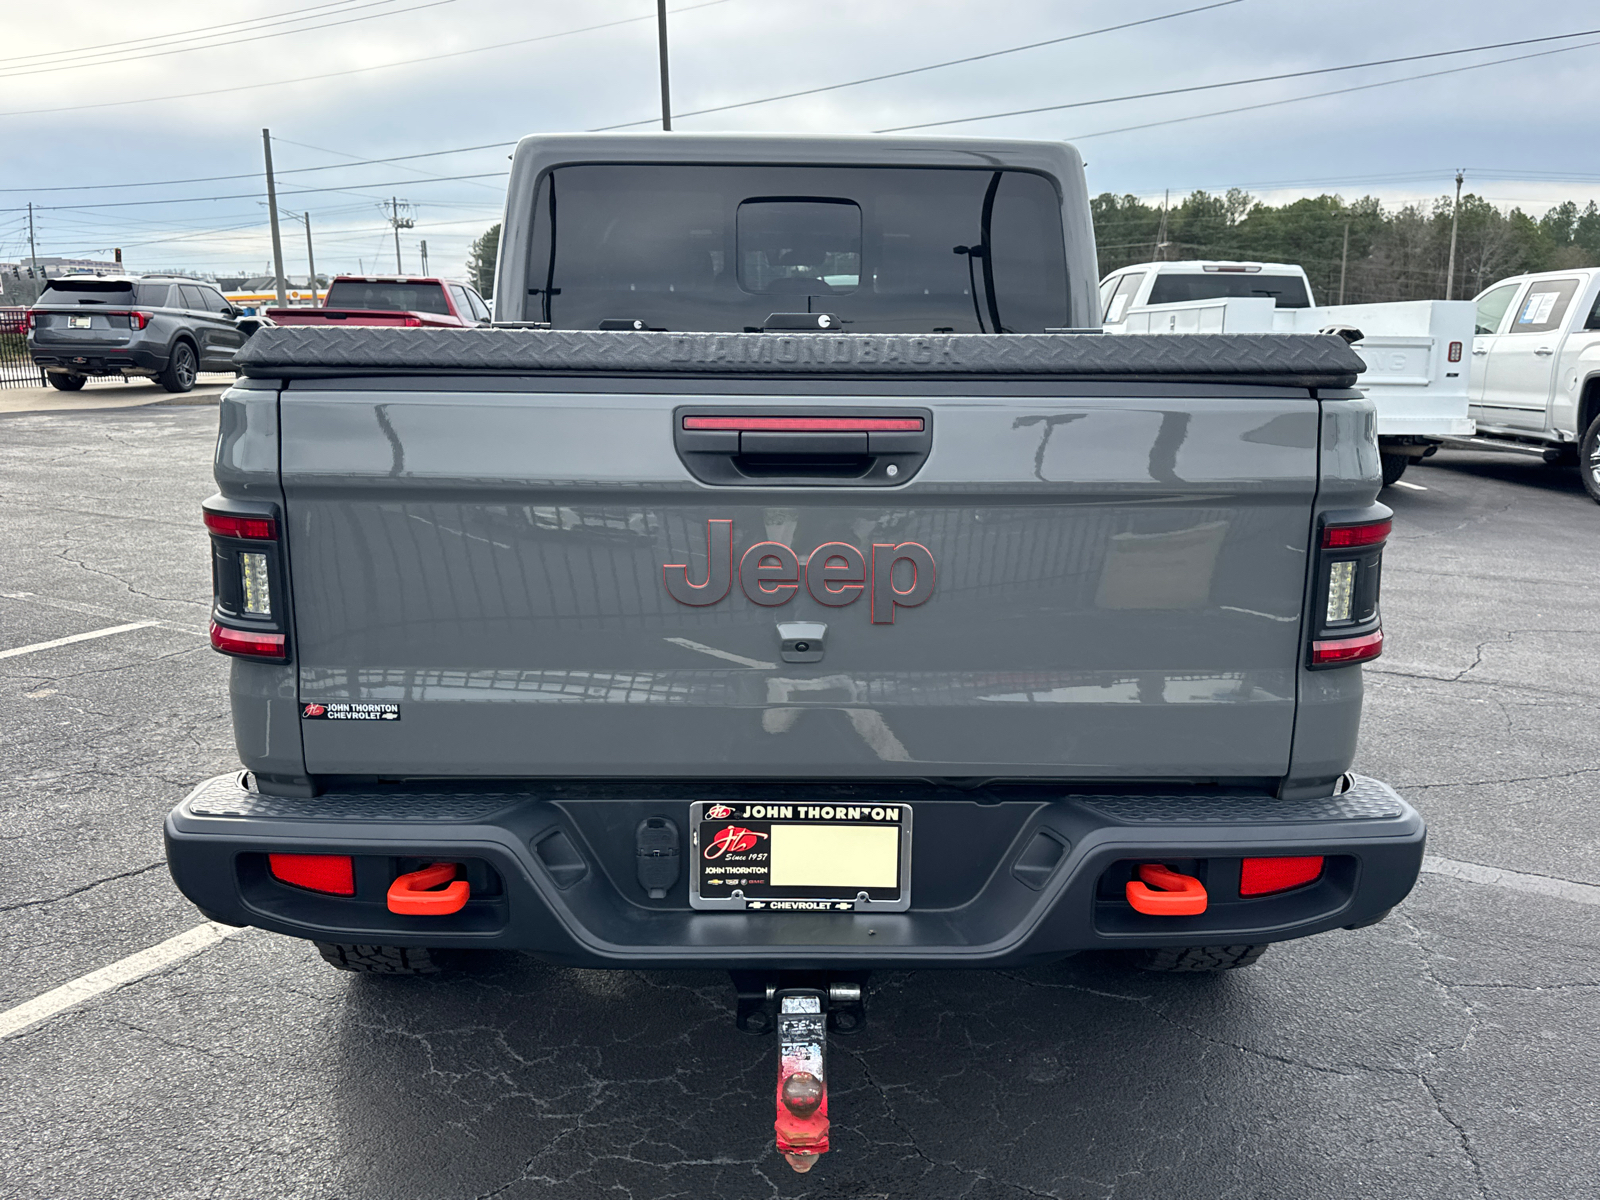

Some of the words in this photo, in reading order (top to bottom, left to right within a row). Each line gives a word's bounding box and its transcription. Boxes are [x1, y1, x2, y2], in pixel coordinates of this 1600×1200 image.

[670, 336, 962, 364] DIAMONDBACK
[663, 519, 936, 624] Jeep
[327, 703, 350, 712] JOHN
[351, 703, 398, 713] THORNTON
[327, 711, 381, 720] CHEVROLET
[743, 805, 793, 819] JOHN
[798, 806, 899, 821] THORNTON
[725, 853, 747, 861] Since
[748, 852, 768, 861] 1957
[705, 867, 725, 875] JOHN
[770, 901, 832, 910] CHEVROLET
